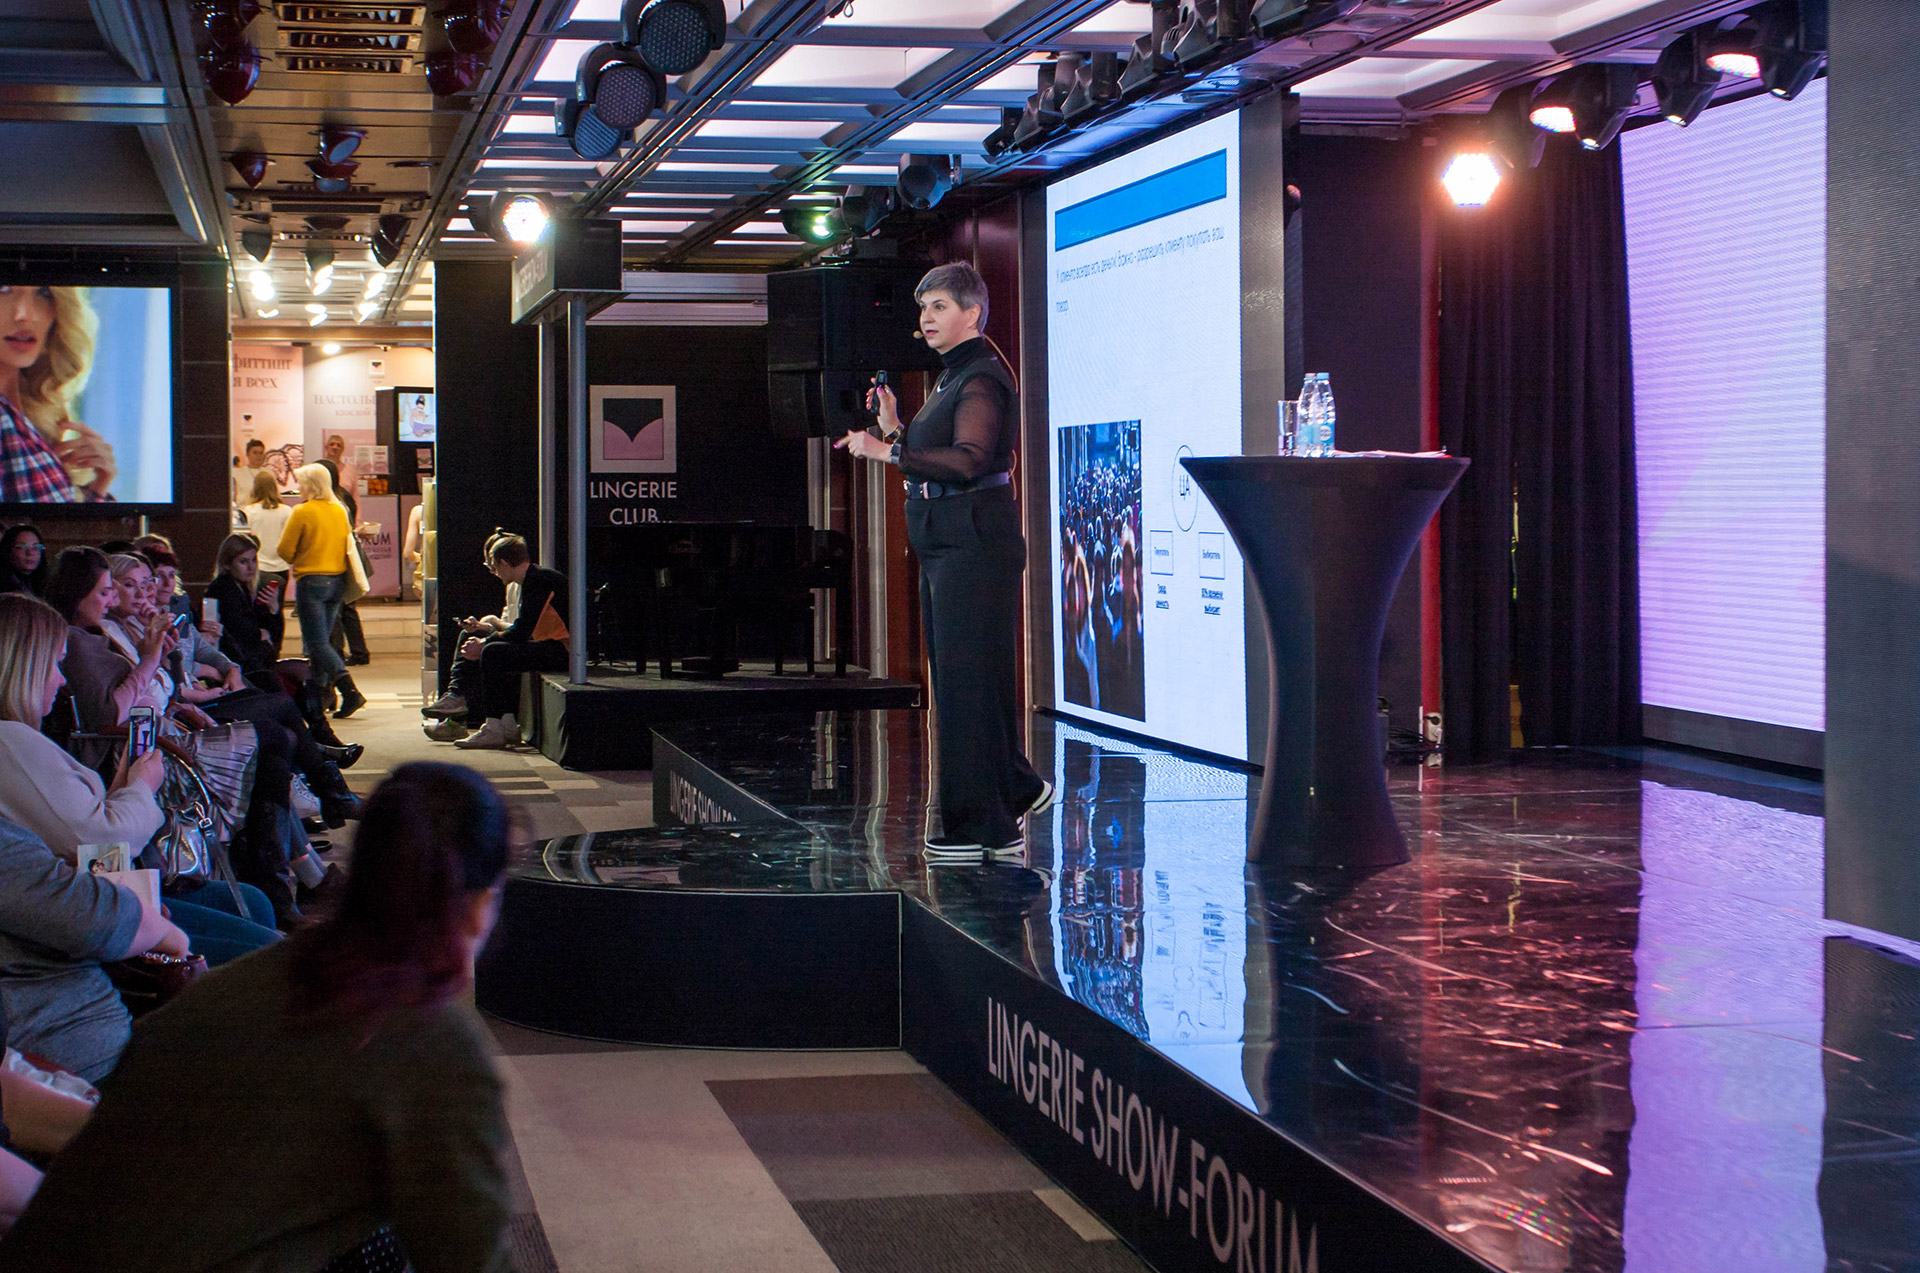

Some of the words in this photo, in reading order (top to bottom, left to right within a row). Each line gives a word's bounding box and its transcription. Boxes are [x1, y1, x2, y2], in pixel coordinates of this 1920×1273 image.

[246, 377, 278, 388] всех
[590, 481, 678, 499] LINGERIE
[609, 508, 660, 525] CLUB
[988, 996, 1085, 1145] LINGERIE
[1091, 1067, 1320, 1273] SHOW-FORUM
